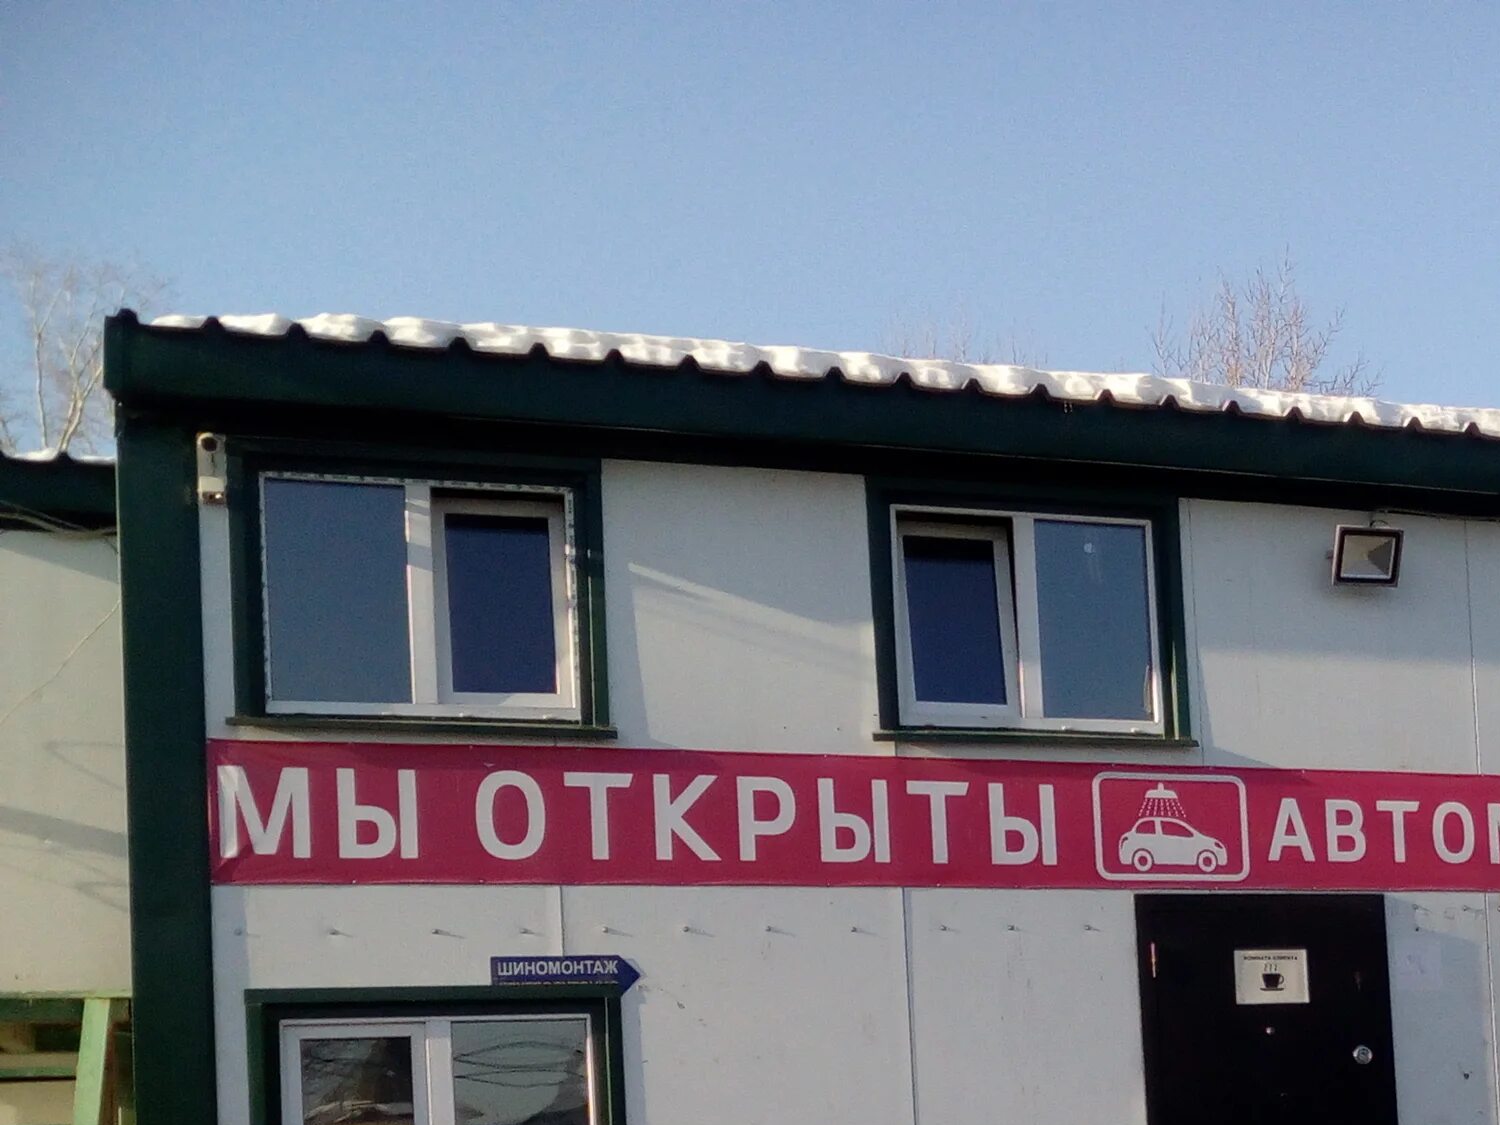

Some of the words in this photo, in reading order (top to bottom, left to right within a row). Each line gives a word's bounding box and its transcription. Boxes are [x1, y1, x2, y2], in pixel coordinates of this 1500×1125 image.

[217, 764, 419, 860] МЫ
[475, 770, 1057, 866] ОТКРЫТЫ
[497, 959, 619, 976] ШИНОМОНТАЖ
